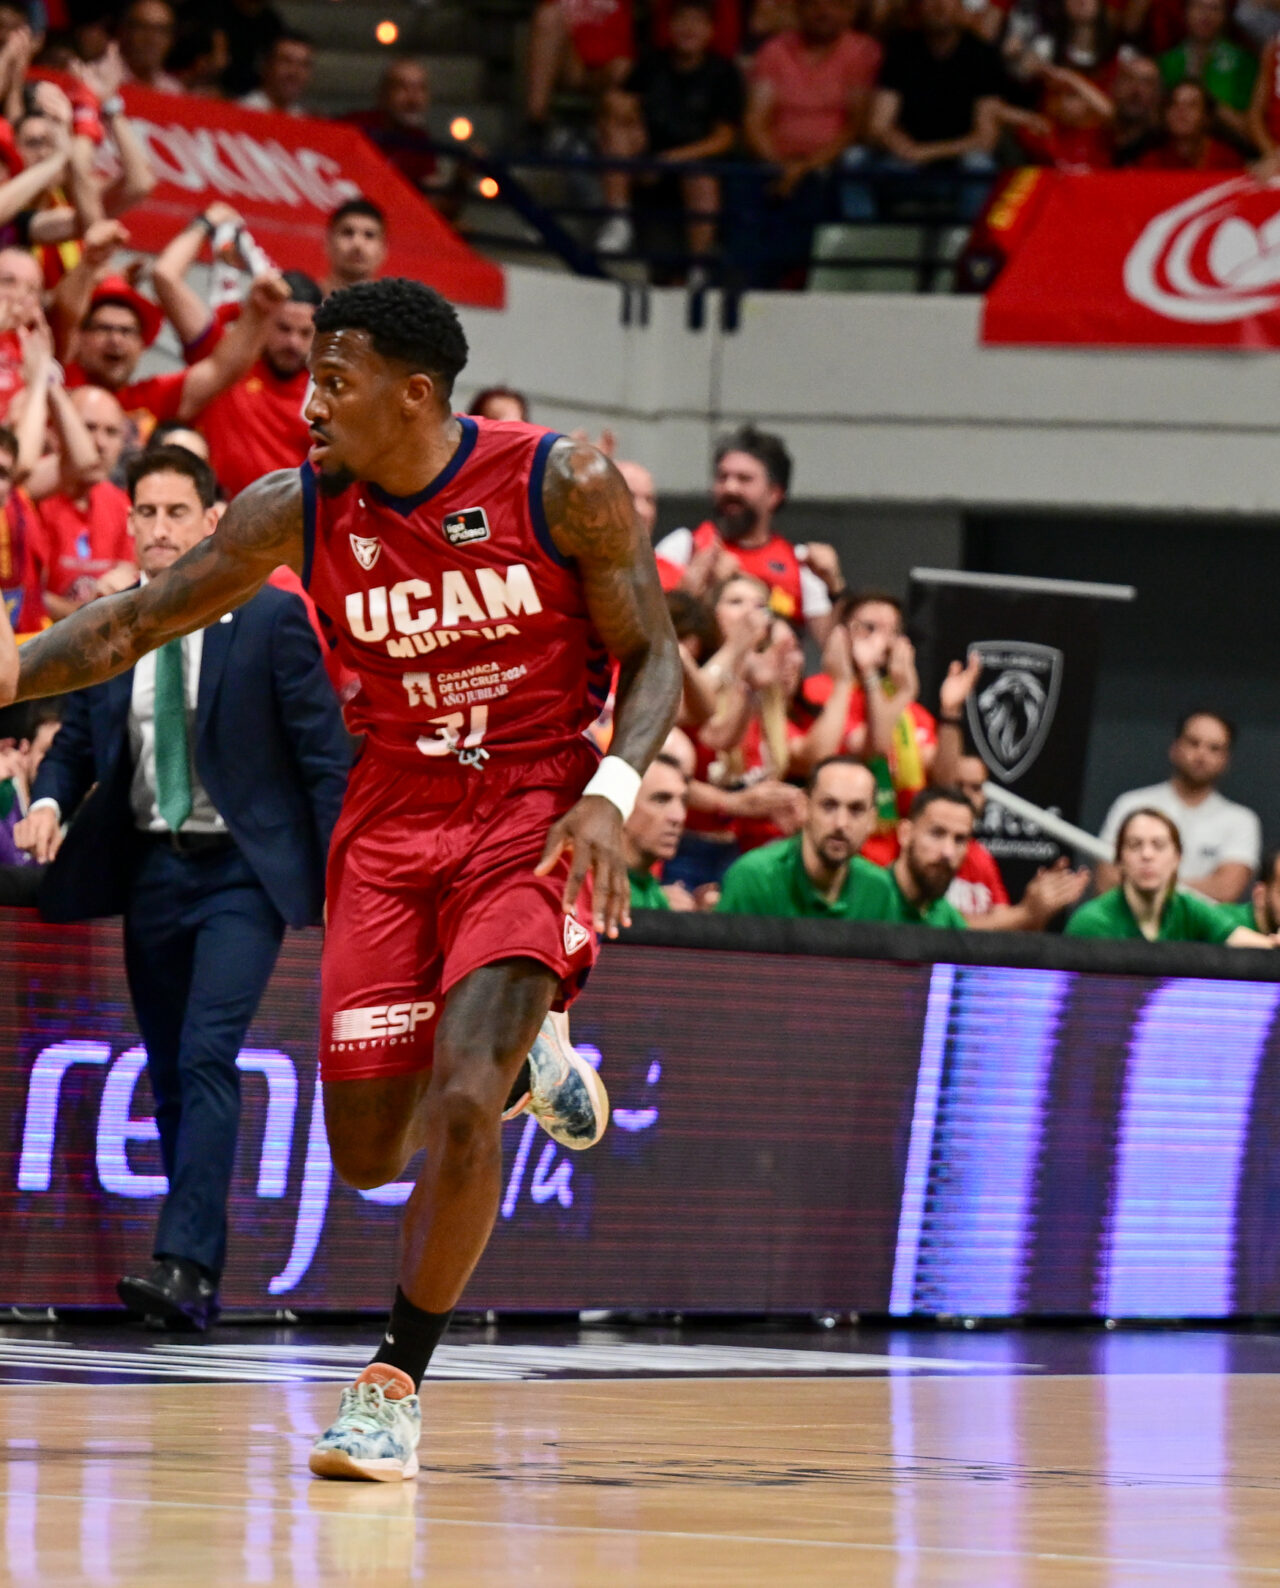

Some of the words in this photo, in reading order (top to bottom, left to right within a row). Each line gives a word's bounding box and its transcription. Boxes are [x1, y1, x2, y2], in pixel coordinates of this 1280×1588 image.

[447, 522, 465, 534] liga
[450, 527, 485, 542] endesa
[345, 563, 543, 643] UCAM
[437, 661, 500, 682] CARAVACA
[439, 682, 454, 694] DE
[455, 679, 469, 690] LA
[470, 673, 500, 687] CRUZ
[500, 664, 528, 681] 2024
[442, 693, 466, 706] AÑO
[466, 683, 509, 704] JUBILAR
[415, 704, 489, 756] 31
[332, 1001, 436, 1041] ESP
[330, 1035, 415, 1053] SOLUTIONS
